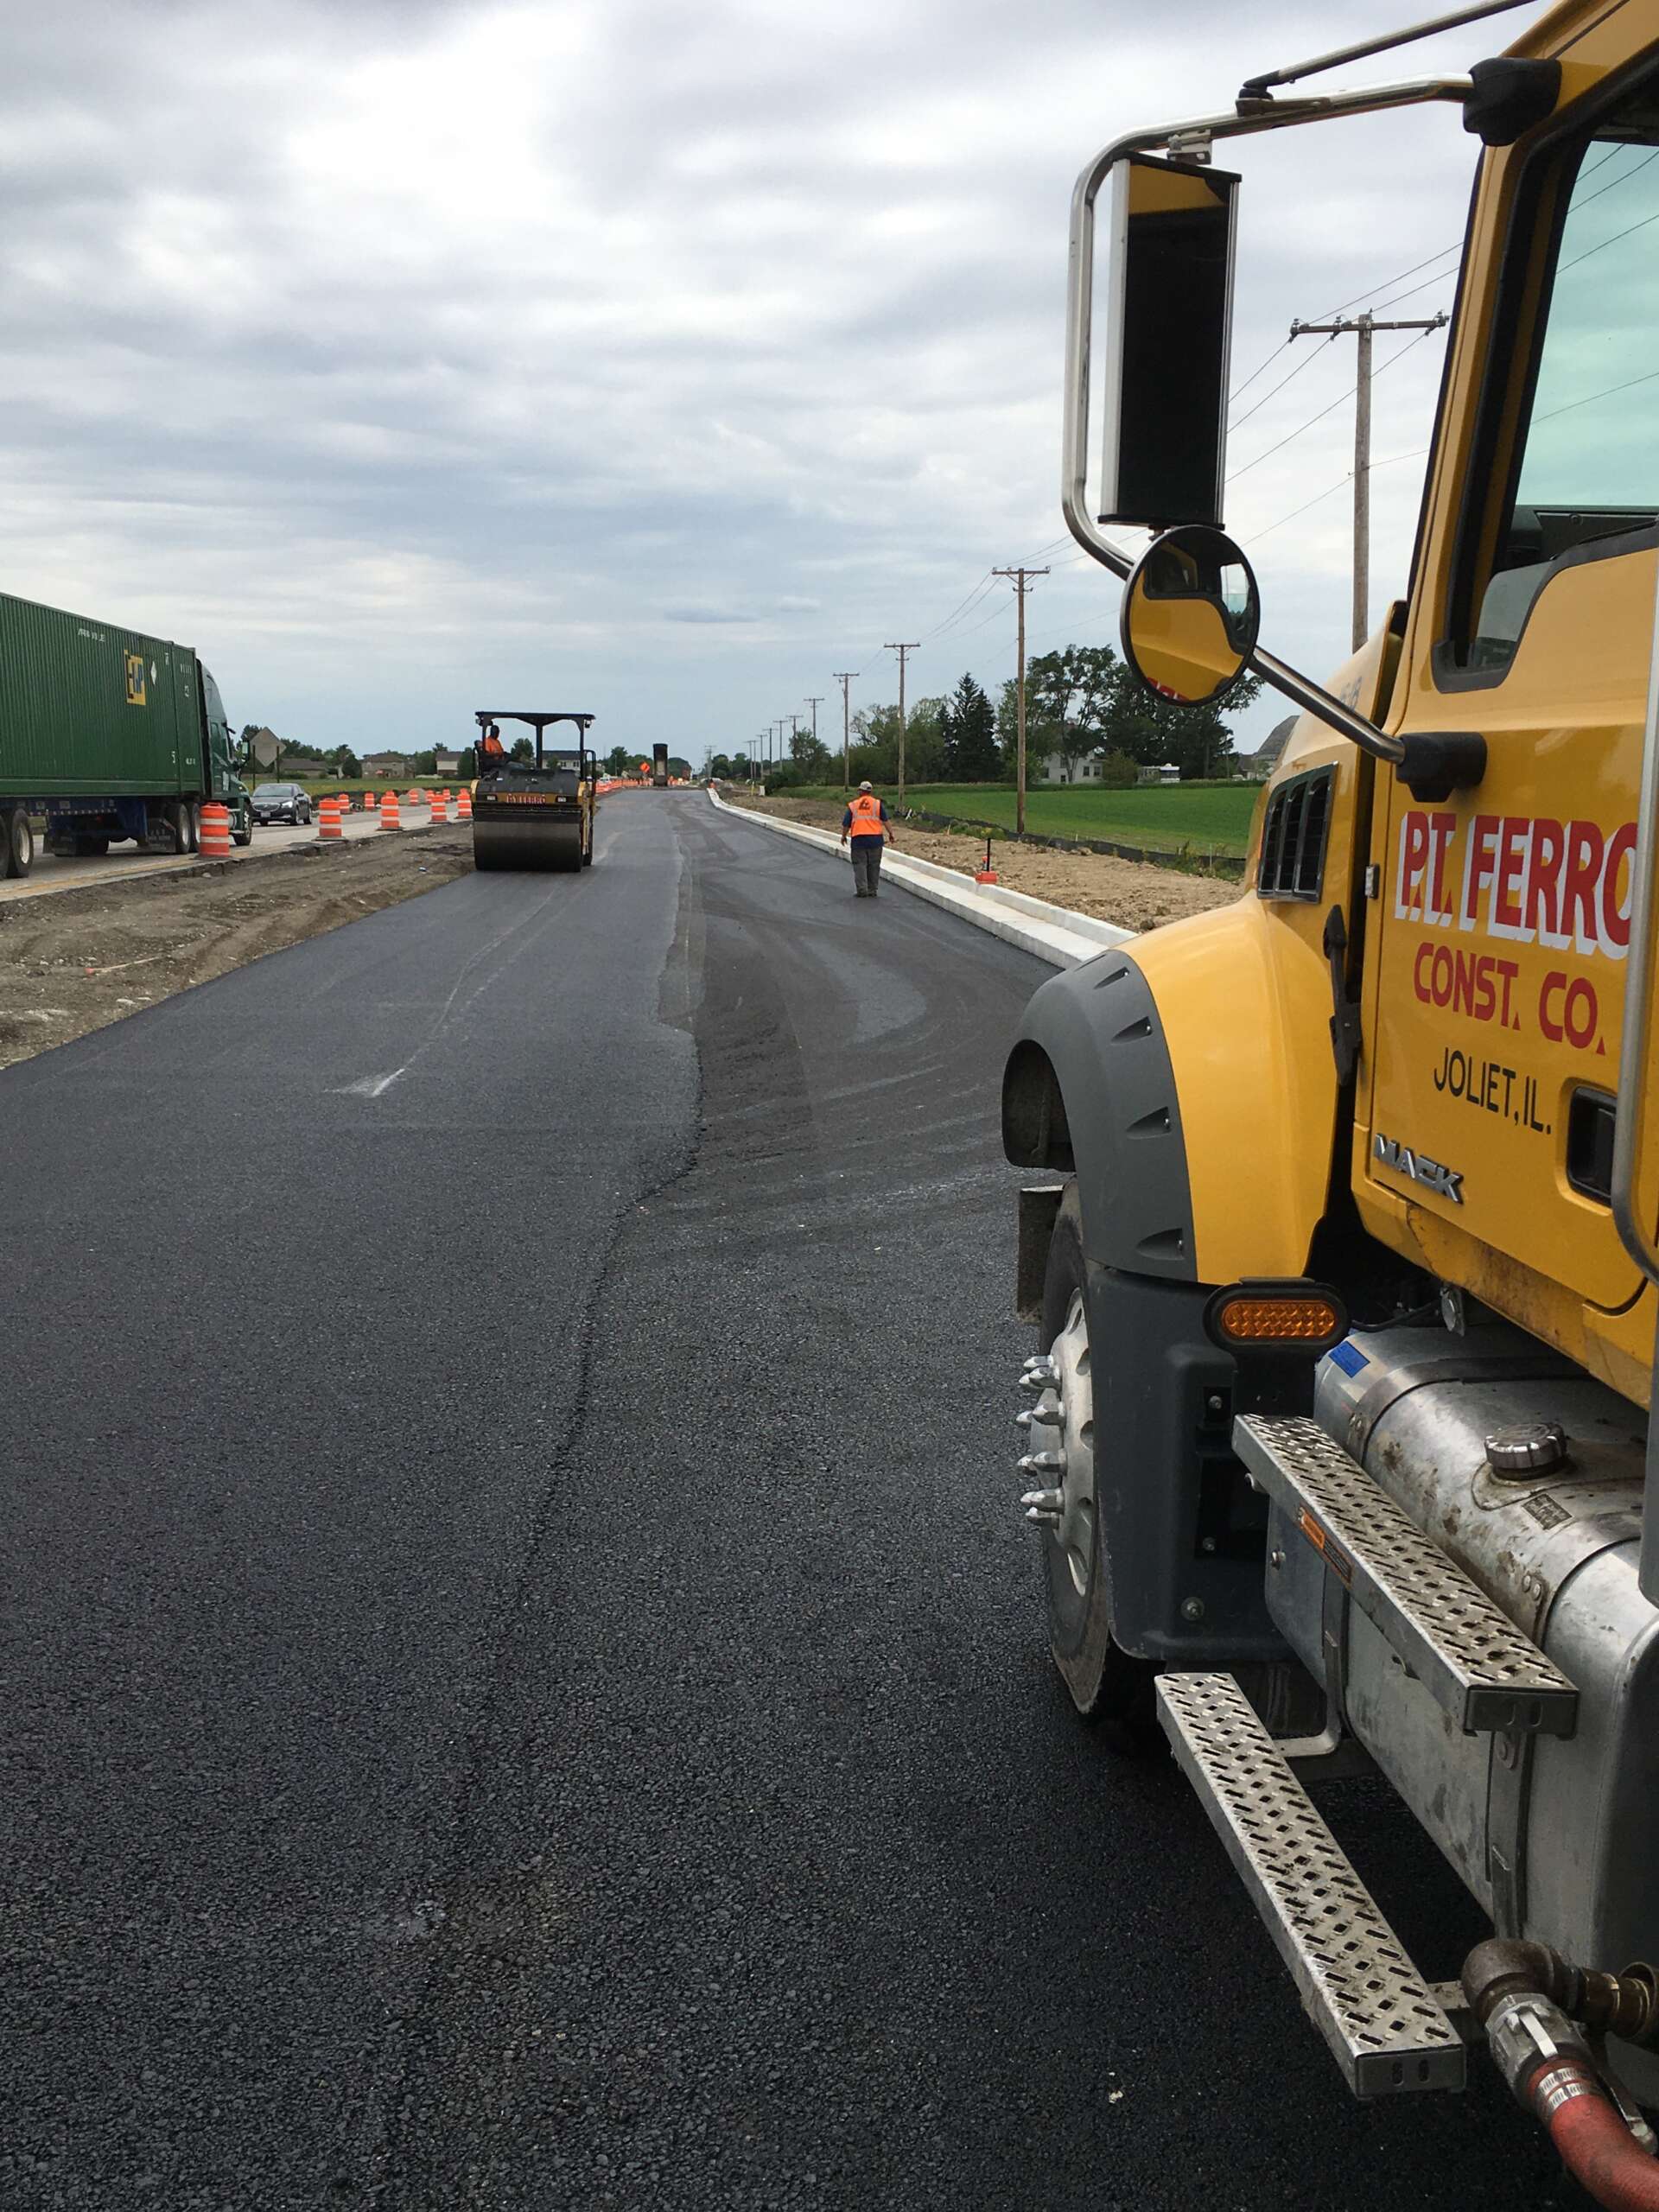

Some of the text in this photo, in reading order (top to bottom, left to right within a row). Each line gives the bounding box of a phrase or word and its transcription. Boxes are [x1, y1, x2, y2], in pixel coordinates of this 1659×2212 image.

[1395, 811, 1637, 960] P.T. FERRO
[1414, 942, 1605, 1056] CONST. CO.
[1374, 1133, 1464, 1205] MACK
